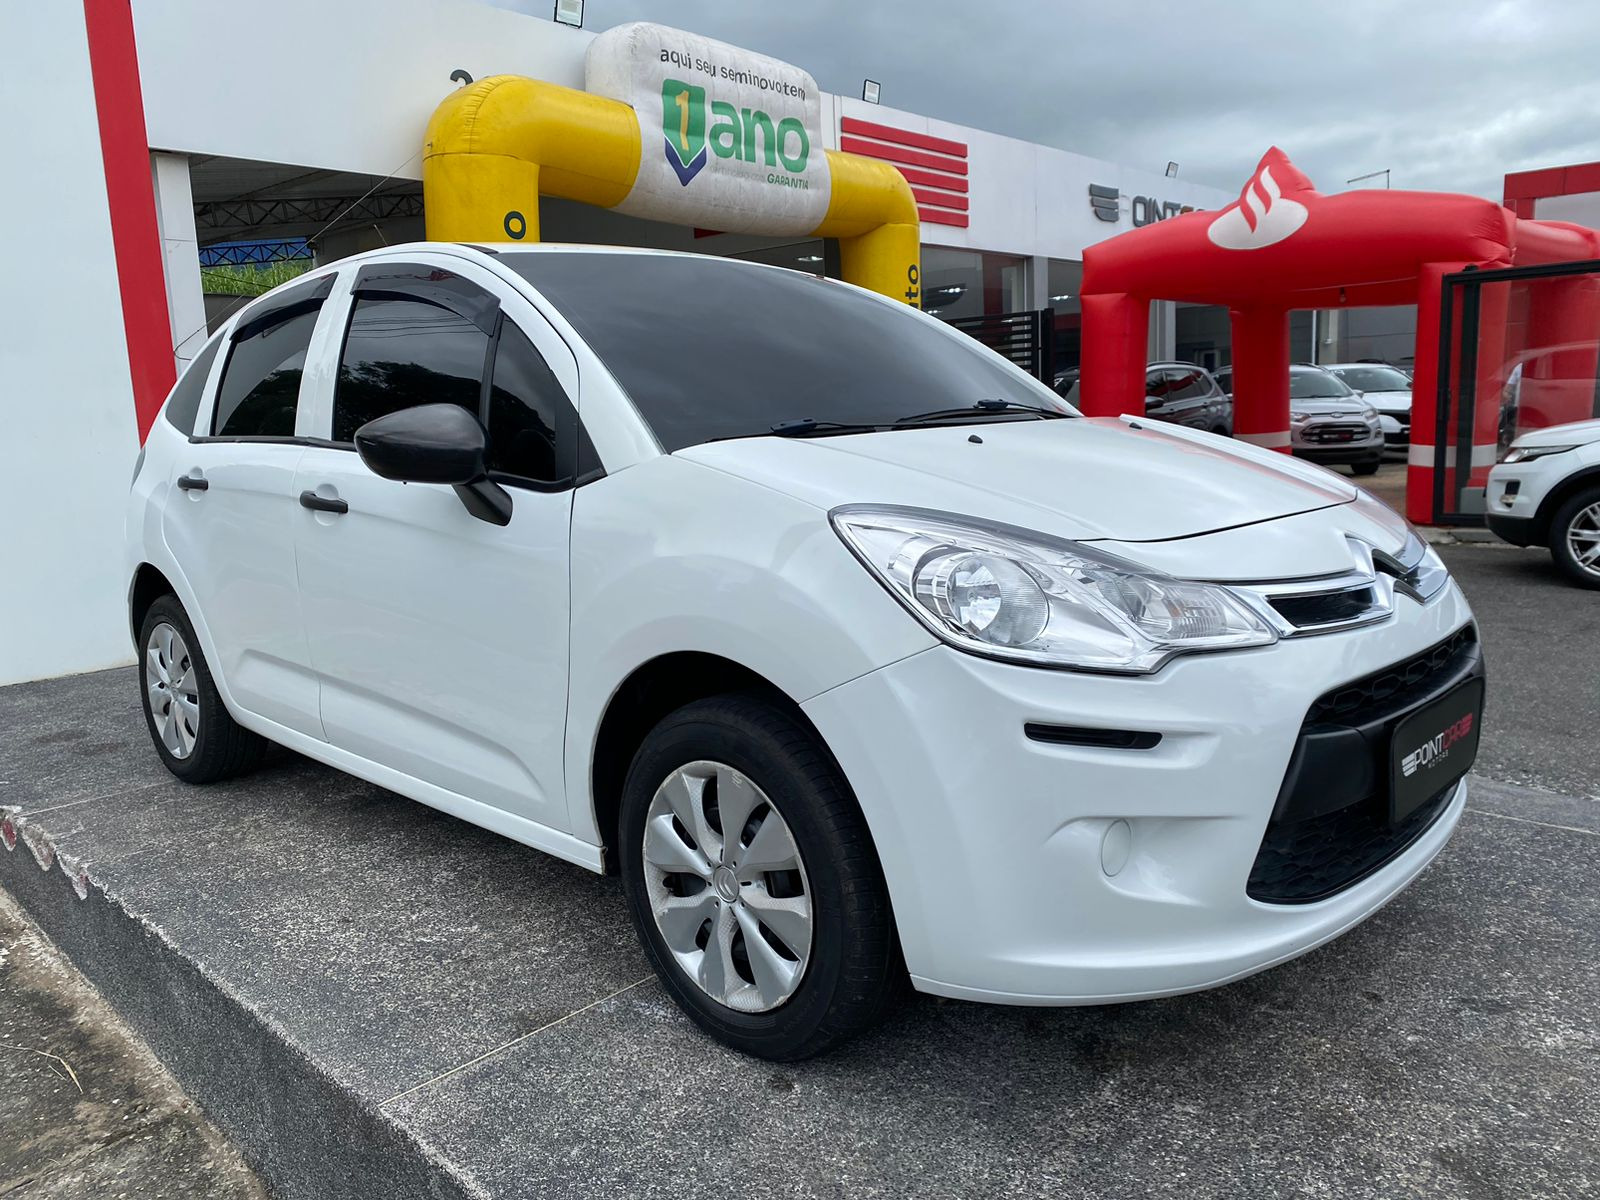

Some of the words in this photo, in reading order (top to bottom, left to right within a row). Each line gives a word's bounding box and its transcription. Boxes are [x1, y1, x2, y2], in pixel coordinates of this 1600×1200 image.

[661, 49, 692, 69] aqui
[695, 58, 716, 77] seu
[720, 66, 782, 94] seminovo
[675, 90, 690, 151] 1
[709, 101, 810, 173] ano
[767, 173, 809, 191] GARANTIA
